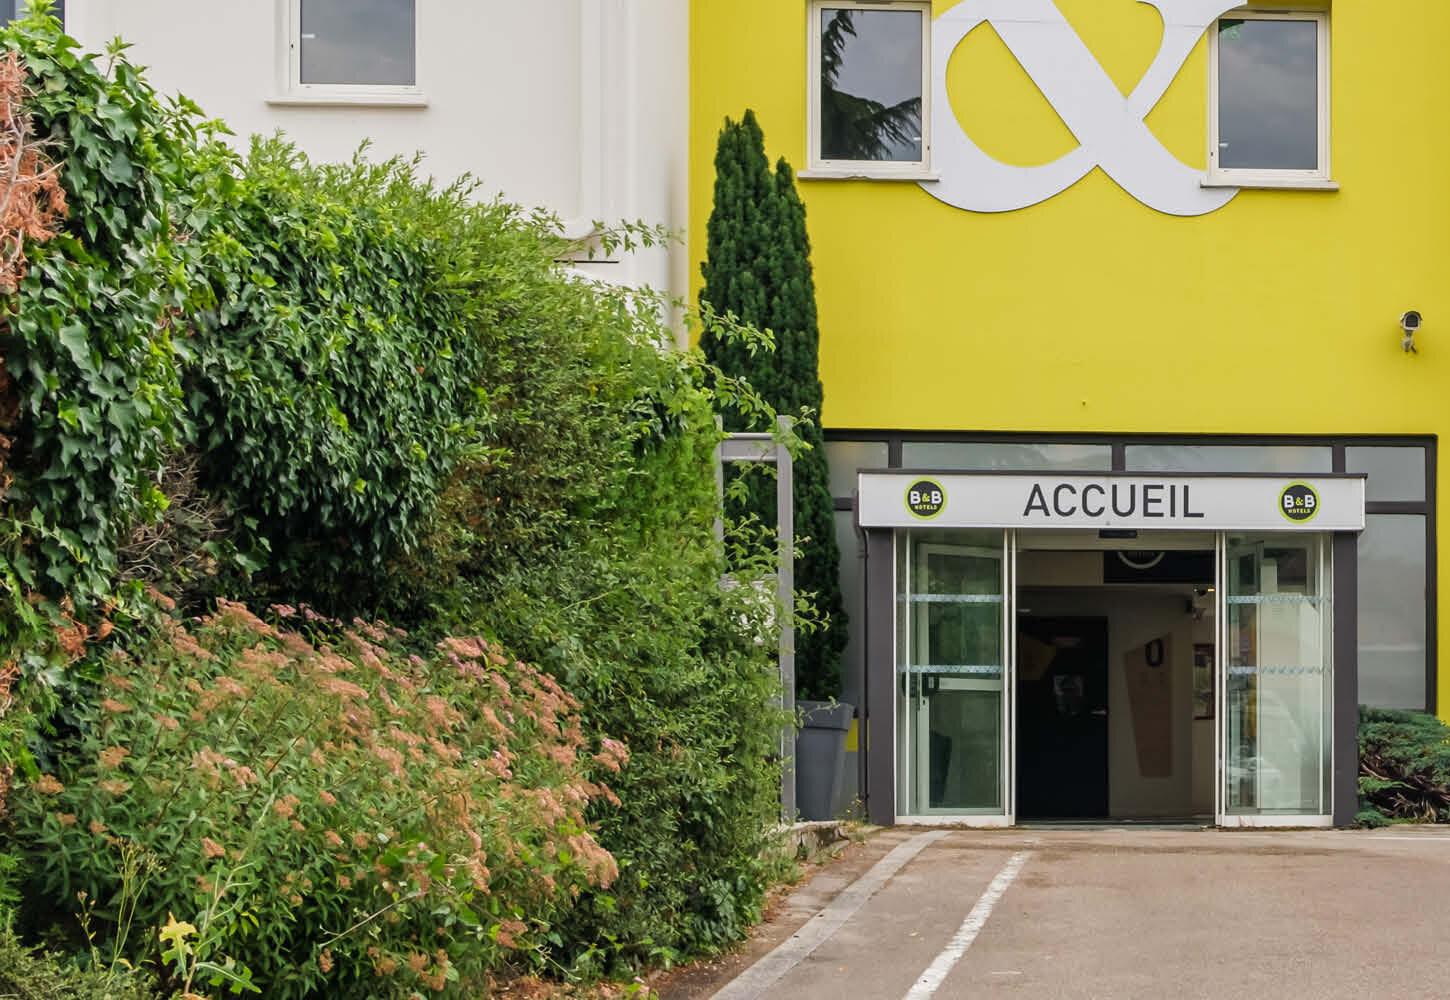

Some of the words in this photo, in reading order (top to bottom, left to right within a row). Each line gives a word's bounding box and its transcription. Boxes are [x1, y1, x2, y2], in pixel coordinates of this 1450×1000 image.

[910, 490, 942, 505] B&B
[1022, 483, 1205, 518] ACCUEIL
[1284, 494, 1316, 508] B&B
